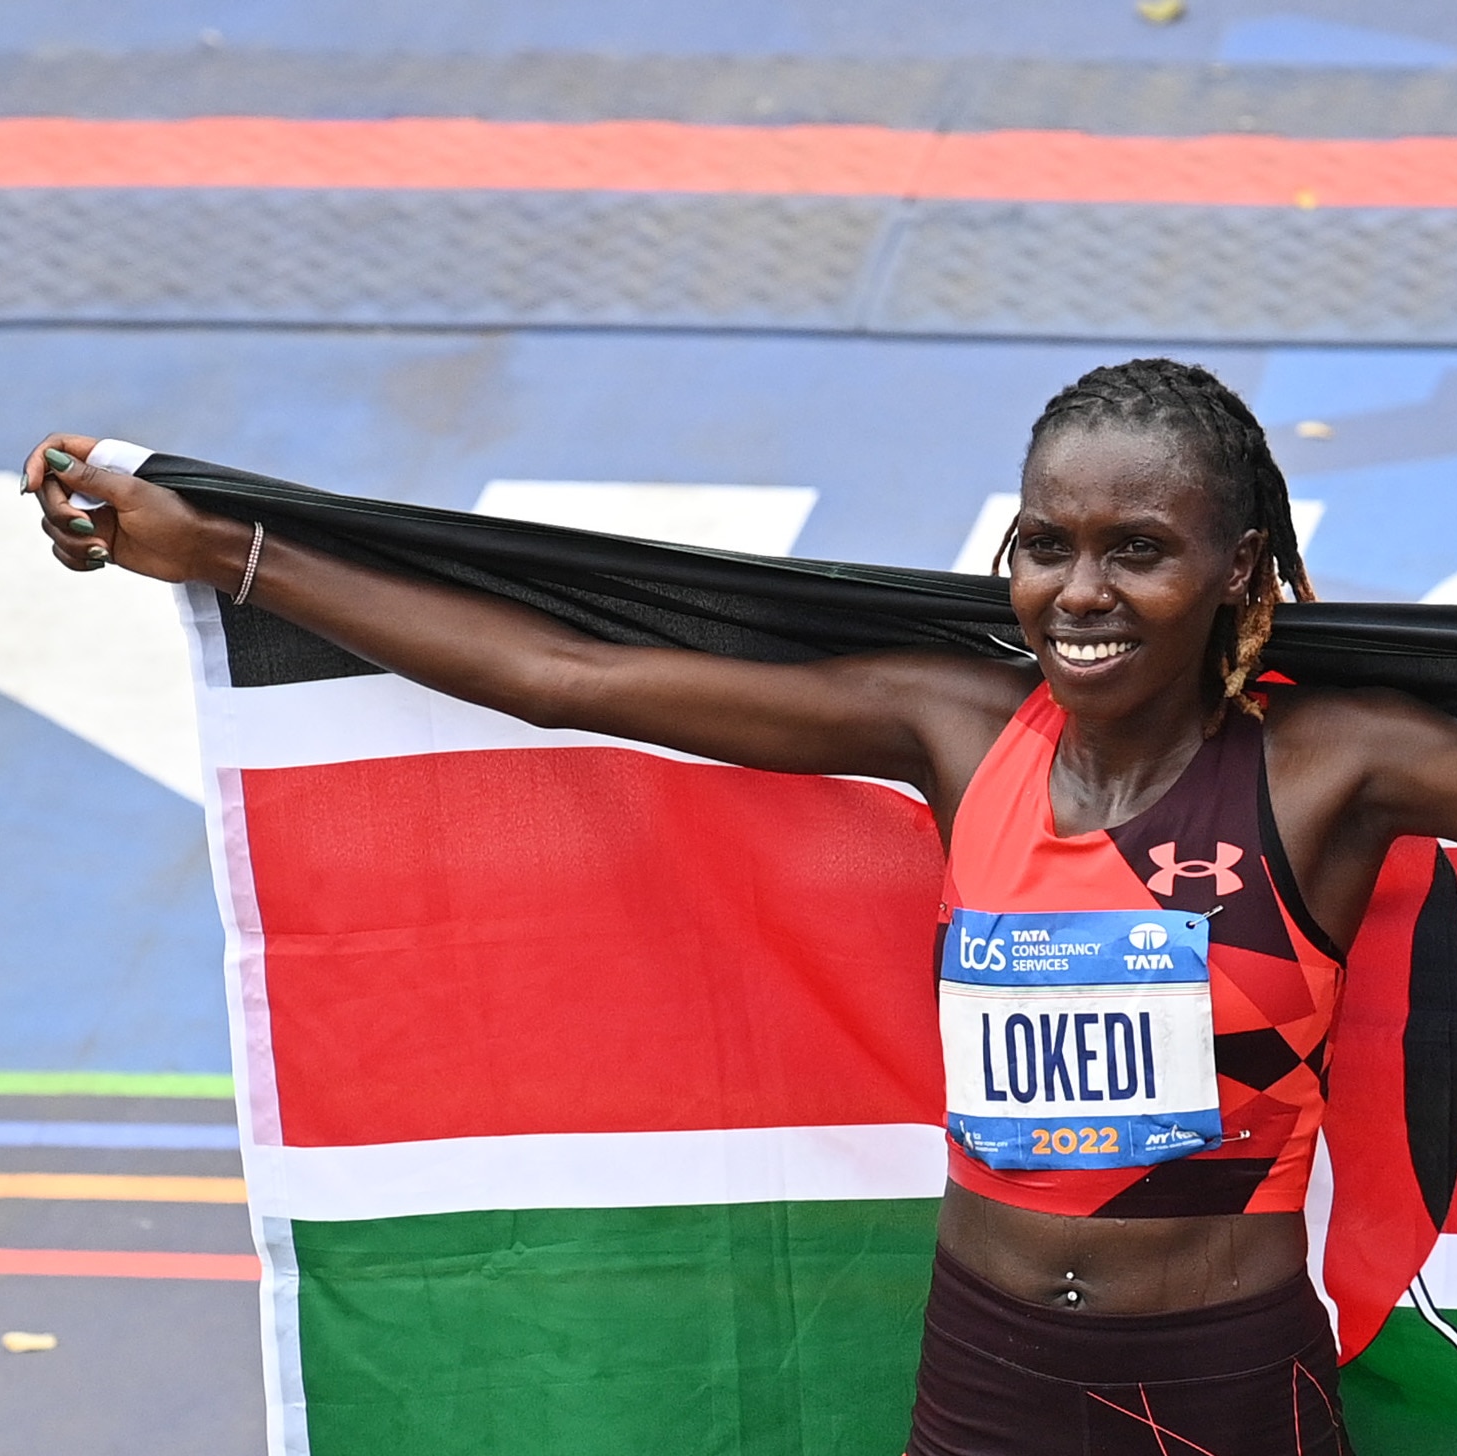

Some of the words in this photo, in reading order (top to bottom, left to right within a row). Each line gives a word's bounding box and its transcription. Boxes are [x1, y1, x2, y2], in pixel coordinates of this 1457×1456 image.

[1012, 930, 1051, 943] TATA
[960, 927, 1007, 972] tcs
[1012, 944, 1102, 957] CONSULTANCY
[1012, 958, 1070, 972] SERVICES
[1123, 954, 1174, 970] TATA
[982, 1011, 1157, 1103] LOKEDI
[1031, 1127, 1120, 1156] 2022
